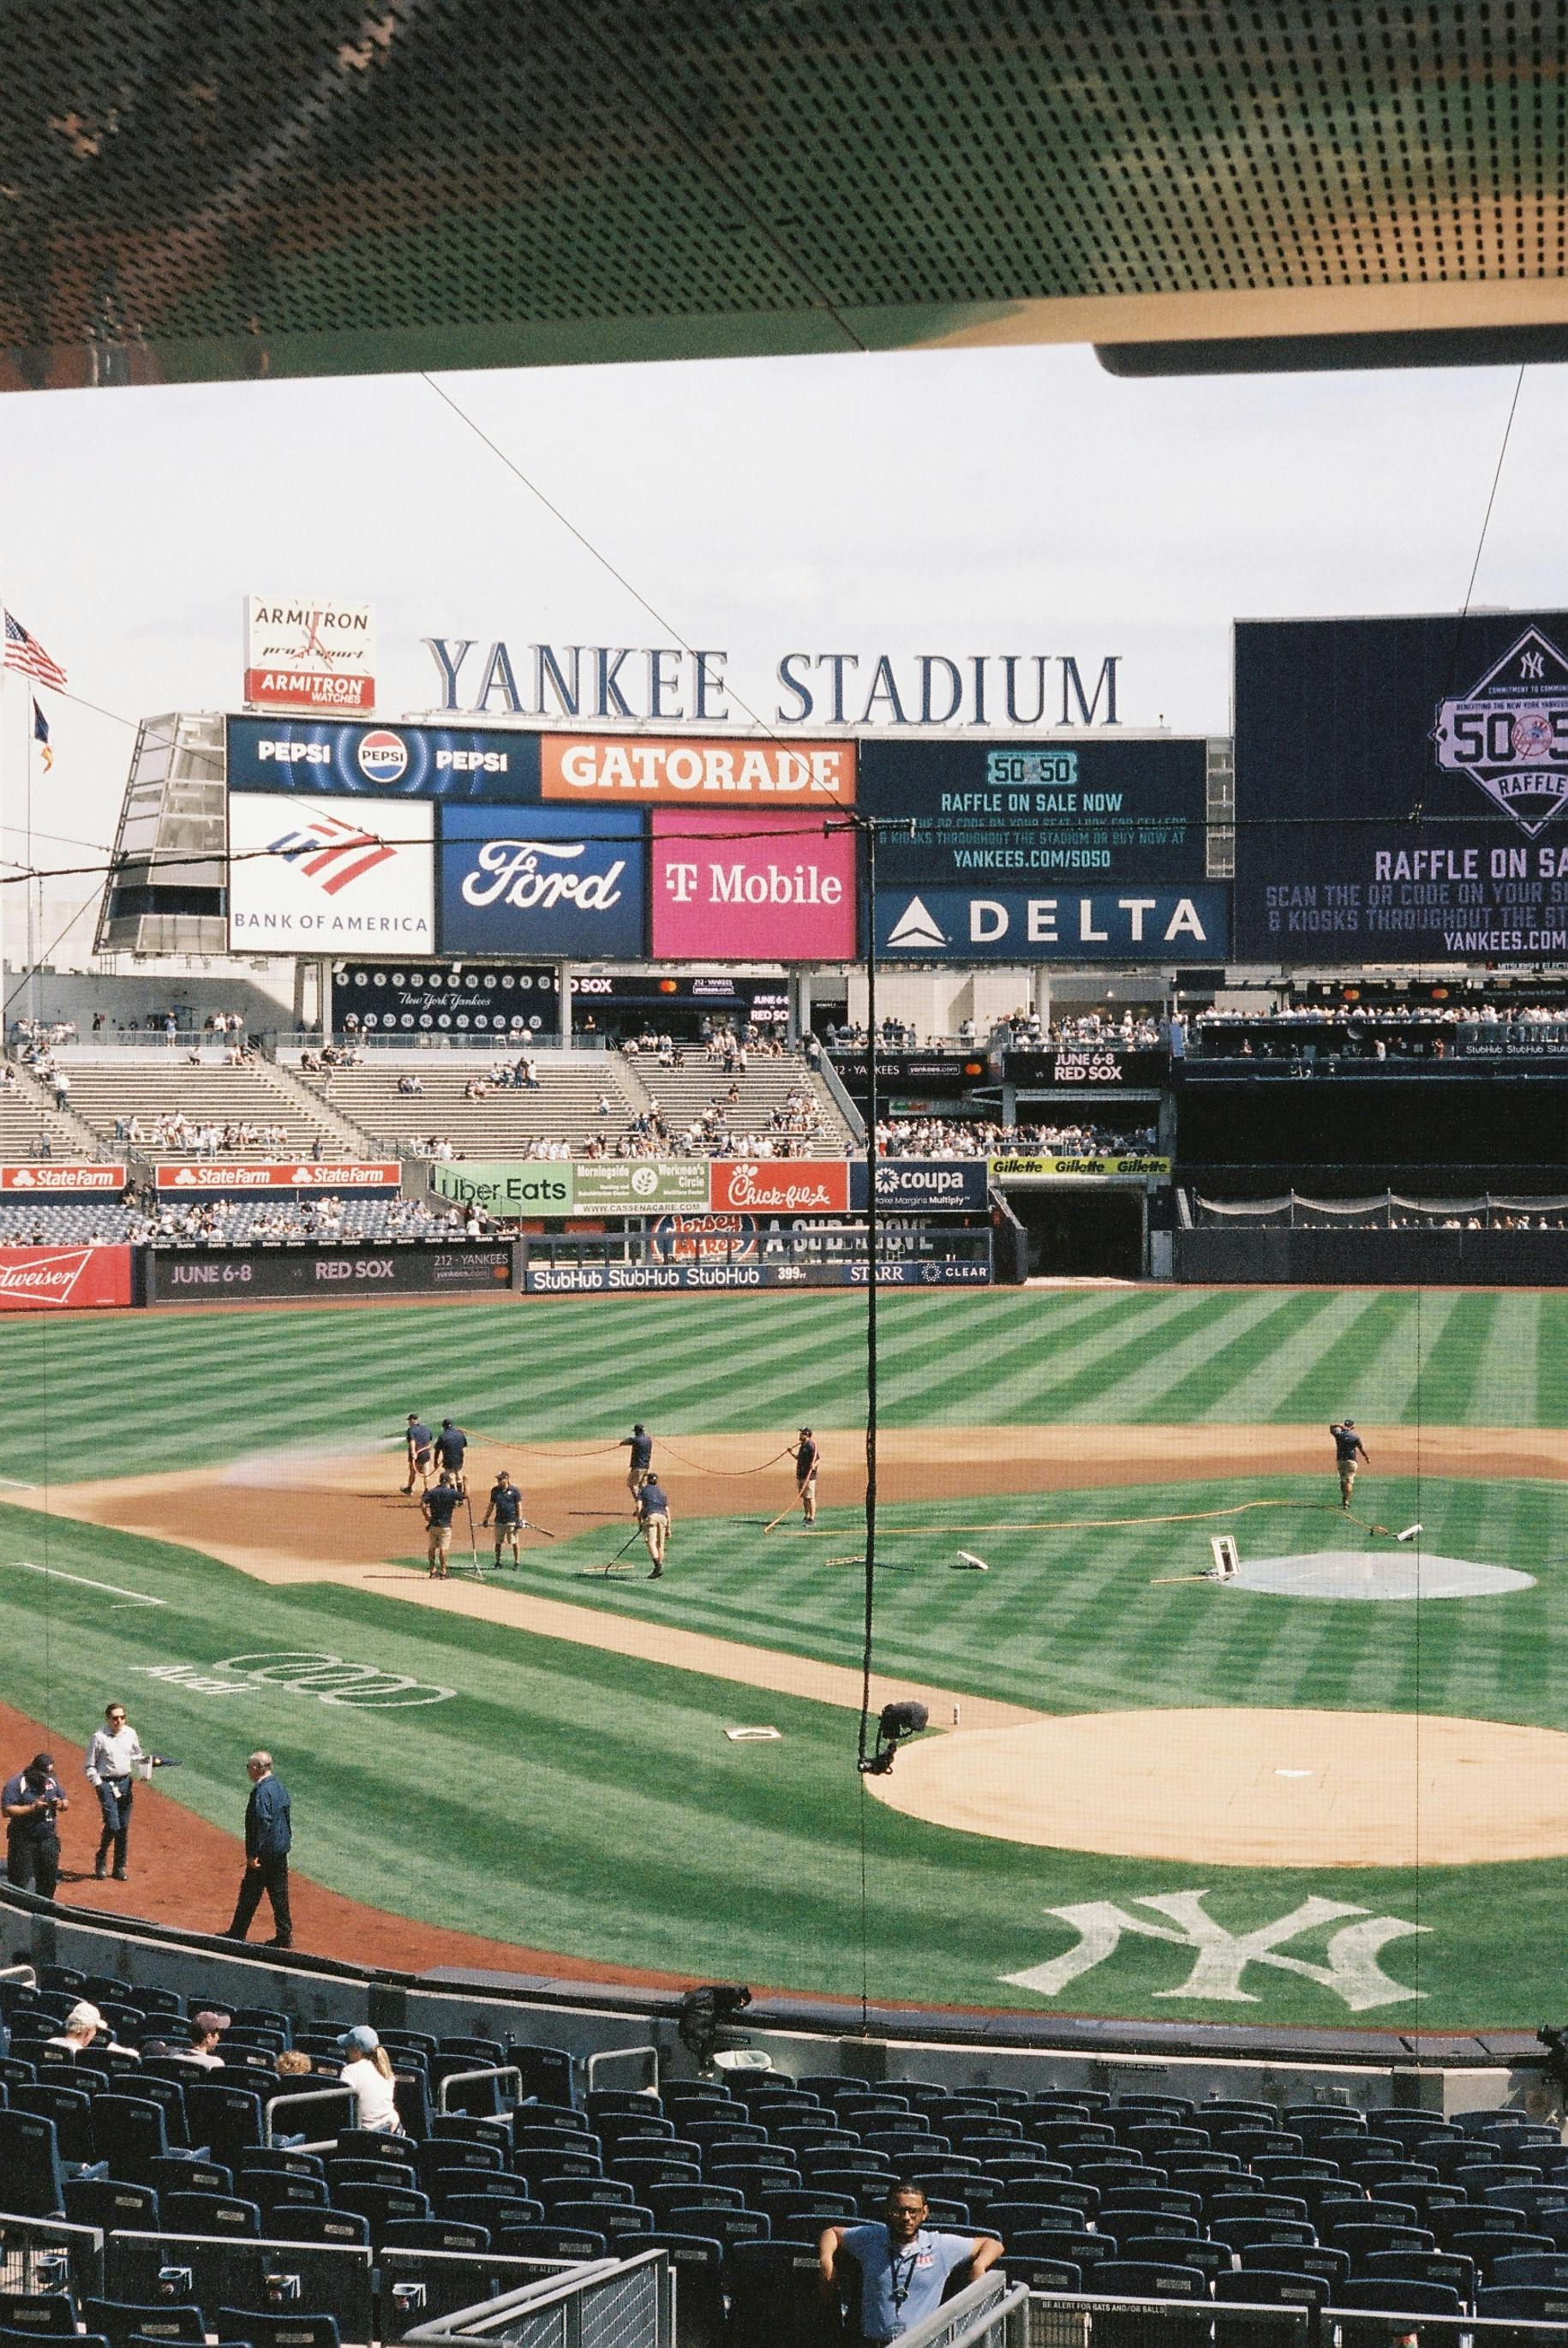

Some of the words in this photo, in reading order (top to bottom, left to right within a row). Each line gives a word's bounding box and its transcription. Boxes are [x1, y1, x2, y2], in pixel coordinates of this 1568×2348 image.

[256, 608, 368, 630] ARMITRON
[261, 674, 363, 694] ARMITRON
[421, 638, 728, 721] YANKEE
[777, 652, 1122, 727] STADIUM
[311, 691, 362, 704] WATCHES
[1454, 712, 1516, 763] 50
[258, 740, 331, 764] PEPSI
[362, 750, 404, 763] PEPSI
[436, 750, 507, 772] PEPSI
[560, 745, 841, 792] GATORADE
[1499, 775, 1566, 795] RAFFLE
[942, 794, 1002, 812] RAFFLE
[1008, 794, 1029, 811] ON
[1036, 794, 1077, 811] SALE
[1083, 794, 1122, 811] NOW
[937, 831, 1009, 844] THROUGHOUT
[1014, 831, 1034, 844] THE
[1039, 831, 1089, 844] STADIUM
[1093, 831, 1108, 844] OR
[1112, 831, 1134, 844] BUY
[1138, 831, 1168, 844] NOW
[1171, 831, 1186, 844] AT
[954, 850, 1110, 869] YANKEES.COM/5050
[1375, 849, 1478, 881] RAFFLE
[1490, 848, 1527, 879] ON
[461, 840, 625, 910] Ford
[709, 864, 842, 905] Mobile
[1266, 885, 1317, 907] SCAN
[1325, 884, 1361, 907] THE
[1401, 883, 1451, 905] CODE
[1458, 883, 1483, 904] ON
[1493, 882, 1542, 903] YOUR
[234, 913, 292, 928] BANK
[300, 914, 325, 929] OF
[332, 916, 428, 932] AMERICA
[969, 899, 1207, 942] DELTA
[1289, 910, 1358, 931] KIOSKS
[1366, 908, 1493, 930] THROUGHOUT
[1501, 907, 1536, 928] THE
[580, 979, 613, 993] SOX
[398, 991, 423, 1004] New
[423, 992, 448, 1010] York
[449, 993, 491, 1010] Yankees
[753, 995, 775, 1005] JUNE
[751, 1010, 772, 1021] RED
[1466, 1045, 1503, 1054] StubHub
[1507, 1045, 1543, 1054] StubHub
[1055, 1053, 1089, 1065] JUNE
[1092, 1053, 1115, 1064] 6-8
[853, 1065, 900, 1075] YAKEES
[909, 1065, 958, 1075] yankees.com
[1054, 1067, 1084, 1081] RED
[1088, 1066, 1122, 1081] SOX
[577, 1165, 630, 1179] Morningside
[658, 1164, 704, 1176] Workmen's
[993, 1160, 1043, 1173] Gillette
[1055, 1160, 1104, 1173] Gillette
[1117, 1160, 1167, 1173] Gillette
[442, 1178, 499, 1201] Uber
[506, 1178, 566, 1201] Eats
[679, 1176, 704, 1188] Circle
[728, 1171, 830, 1207] Chick-fil-A
[901, 1171, 963, 1192] coupa
[583, 1203, 700, 1212] WWW.CASSENACARE.COM
[895, 1196, 927, 1206] Margins
[667, 1213, 742, 1234] Jersey
[434, 1255, 452, 1266] 212
[461, 1254, 508, 1265] YANKEES
[172, 1265, 219, 1284] JUNE
[223, 1264, 252, 1282] 6-8
[315, 1261, 352, 1279] RED
[355, 1260, 395, 1279] SOX
[534, 1272, 602, 1289] StubHub
[608, 1269, 679, 1287] StubHub
[686, 1267, 760, 1285] StubHub
[946, 1267, 986, 1277] CLEAR
[1092, 2303, 1110, 2312] BATS
[1111, 2304, 1140, 2313] AND/OR
[1143, 2305, 1164, 2314] BALLS
